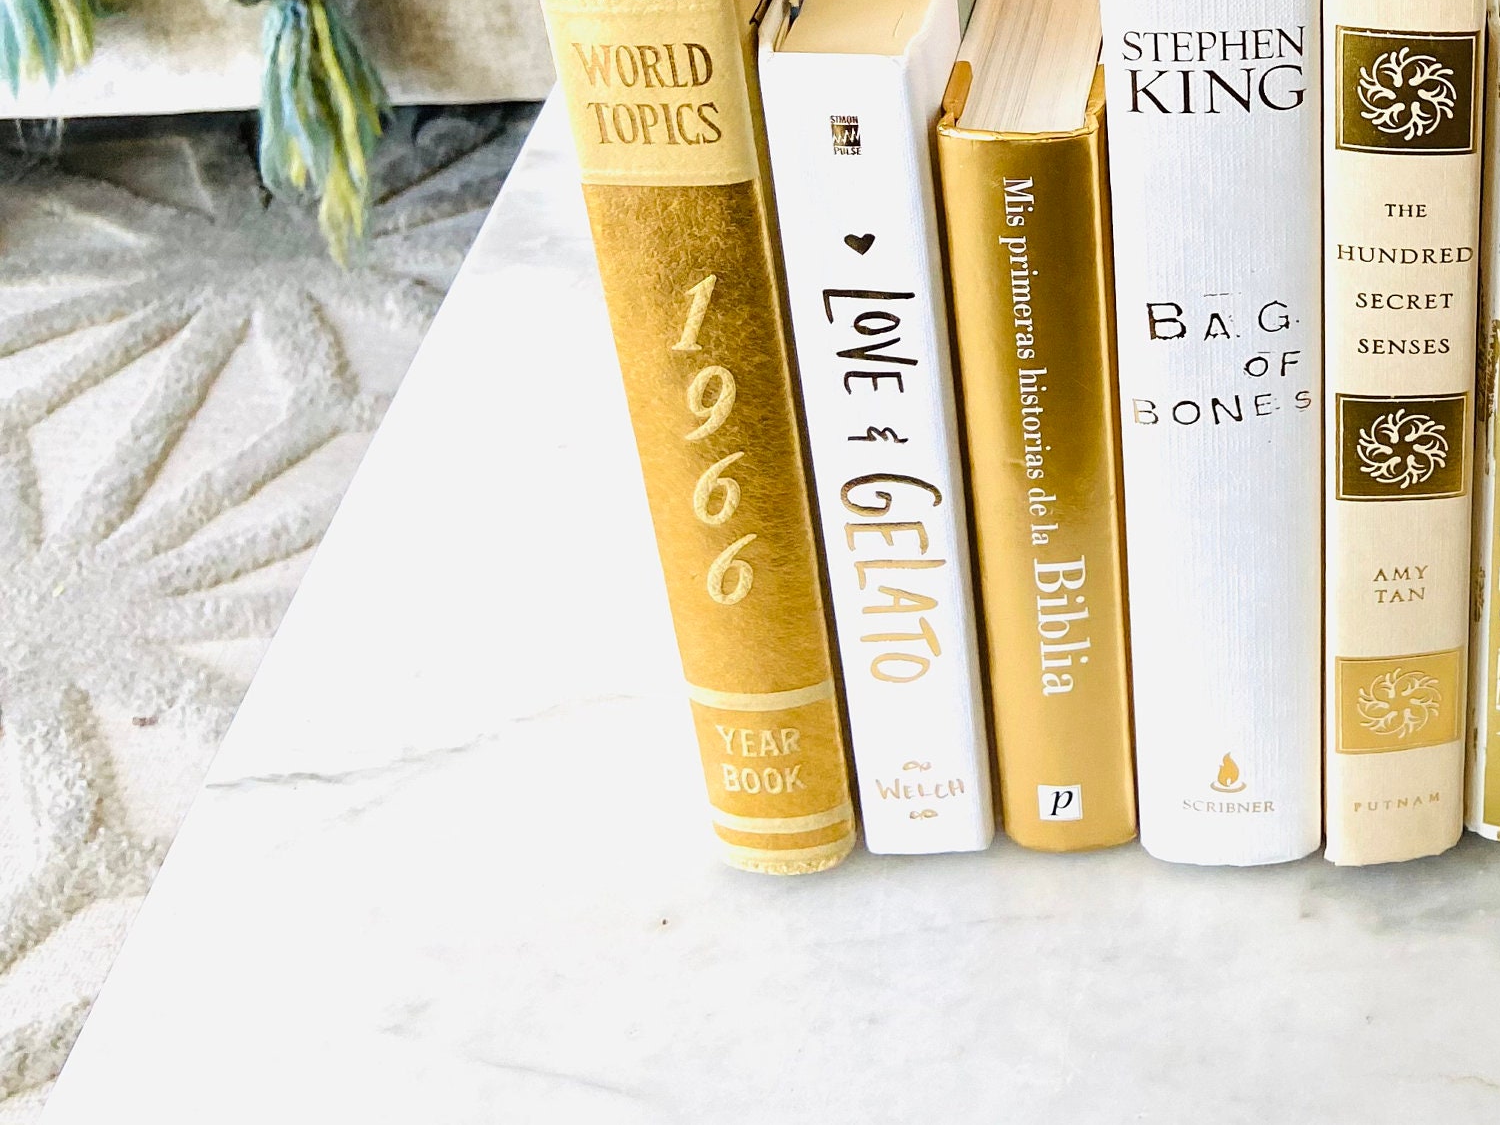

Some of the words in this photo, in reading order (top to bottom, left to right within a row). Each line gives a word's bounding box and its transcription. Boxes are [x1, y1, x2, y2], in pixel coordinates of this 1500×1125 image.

[1122, 25, 1306, 62] STEPHEN
[572, 43, 713, 89] WORLD
[1127, 64, 1307, 114] KING
[587, 101, 723, 145] TOPICS
[1003, 176, 1035, 227] Mis
[1384, 202, 1428, 218] THE
[1336, 243, 1474, 264] HUNDRED
[998, 235, 1039, 360] primeras
[1355, 292, 1454, 310] SECRET
[822, 288, 919, 394] LOVE
[1357, 337, 1451, 355] SENSES
[1243, 350, 1301, 377] OF
[1018, 367, 1051, 480] historias
[1132, 390, 1312, 426] BONES
[670, 273, 757, 606] 1966
[1027, 487, 1057, 516] de
[1030, 523, 1059, 546] la
[839, 473, 947, 684] GELATO
[1372, 565, 1430, 583] AMY
[1374, 586, 1427, 604] TAN
[1033, 554, 1090, 697] Biblia
[715, 725, 802, 758] YEAR
[722, 764, 808, 795] BOOK
[874, 778, 965, 801] WELCH
[1182, 798, 1276, 815] SCRIBNER
[1353, 791, 1442, 813] PUTNAM
